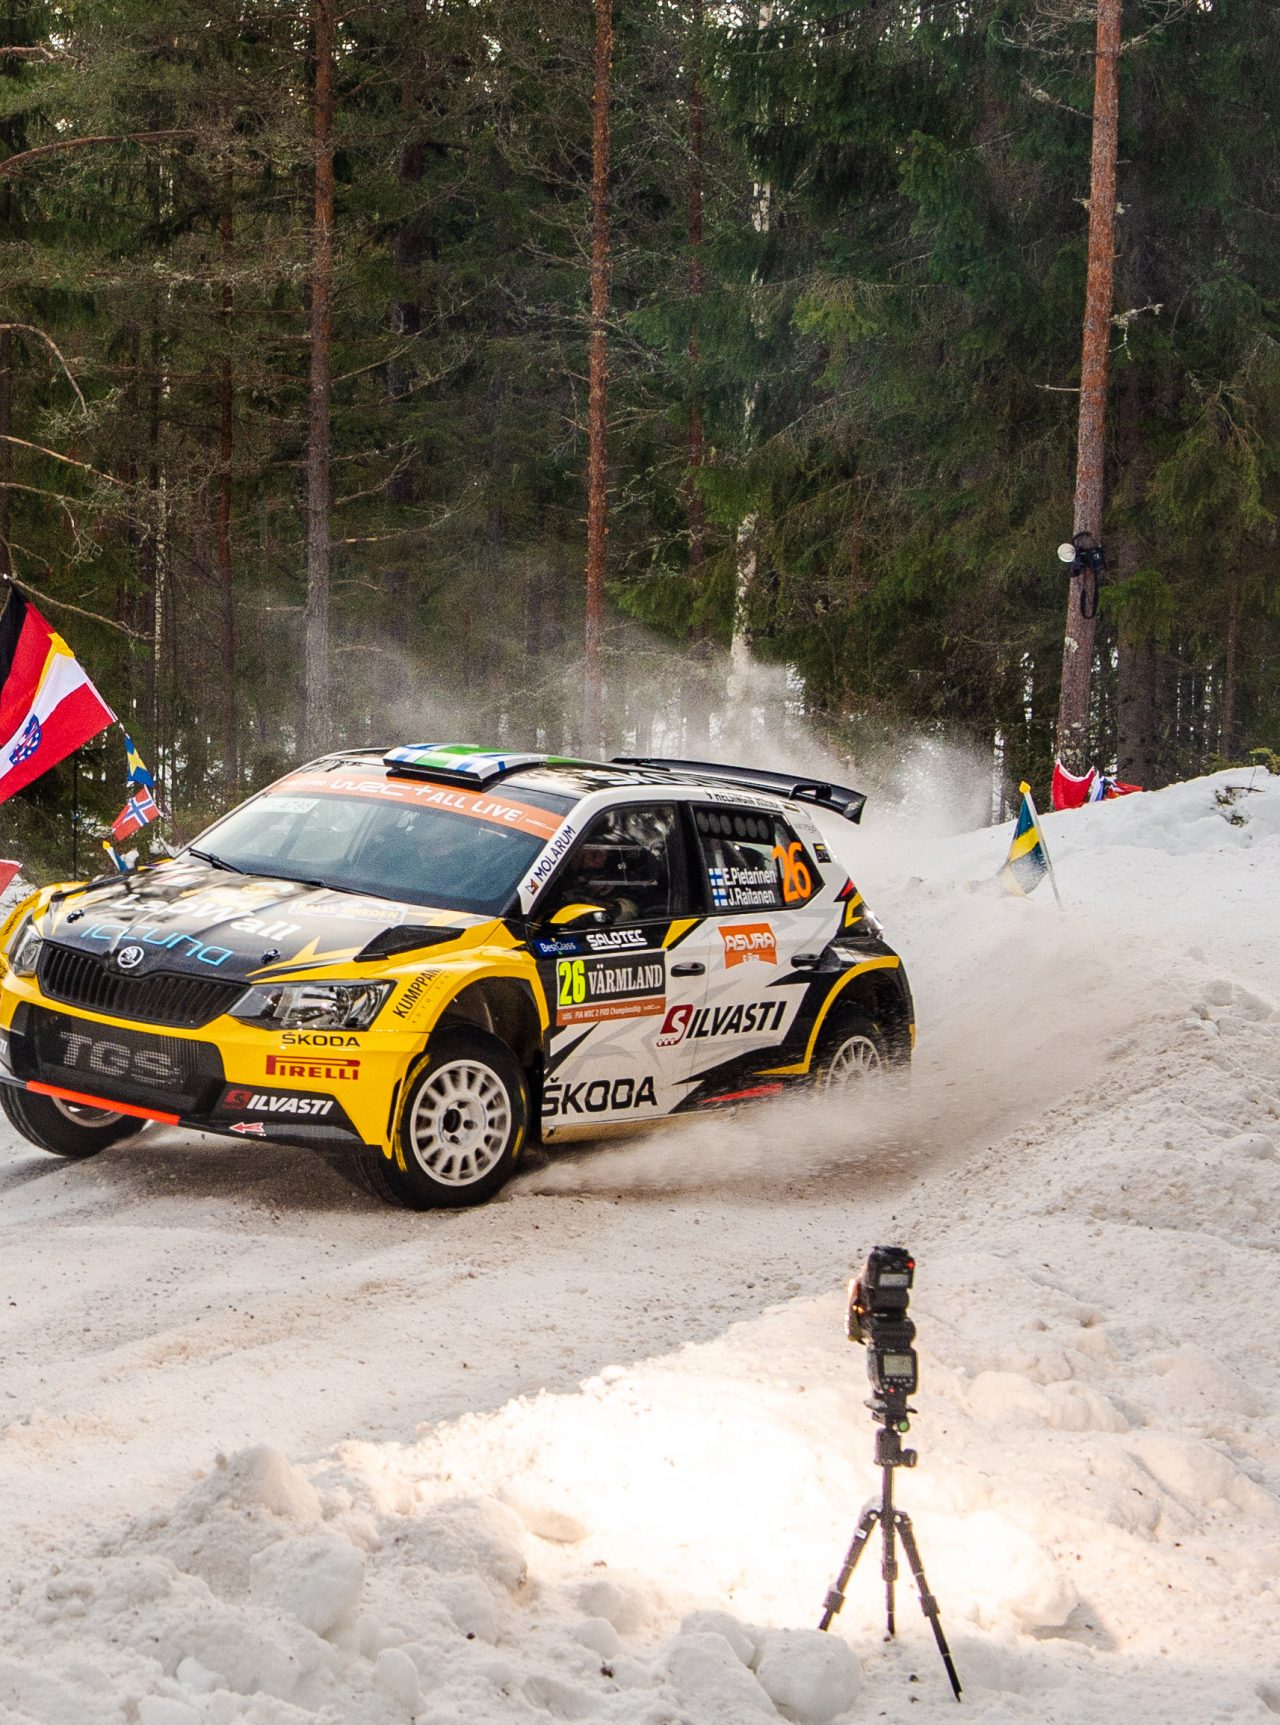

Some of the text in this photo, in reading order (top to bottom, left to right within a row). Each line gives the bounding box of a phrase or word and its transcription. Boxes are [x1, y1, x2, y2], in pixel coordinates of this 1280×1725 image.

[426, 792, 467, 809] ALL
[471, 800, 524, 822] LIVE
[533, 825, 577, 882] MOLARUM
[723, 867, 777, 886] E.Pietarinen
[771, 842, 812, 903] 26
[728, 888, 776, 906] J.Raitanen
[586, 930, 647, 948] SALOTEC
[724, 932, 775, 952] ASURA
[558, 959, 663, 1006] 26 VÄRMLAND
[656, 1001, 788, 1047] SILVASTI
[281, 1032, 361, 1047] ŠKODA
[60, 1031, 183, 1085] TGS
[265, 1054, 361, 1081] PIRELLI
[224, 1089, 334, 1116] SILVASTI
[541, 1076, 658, 1118] ŠKODA
